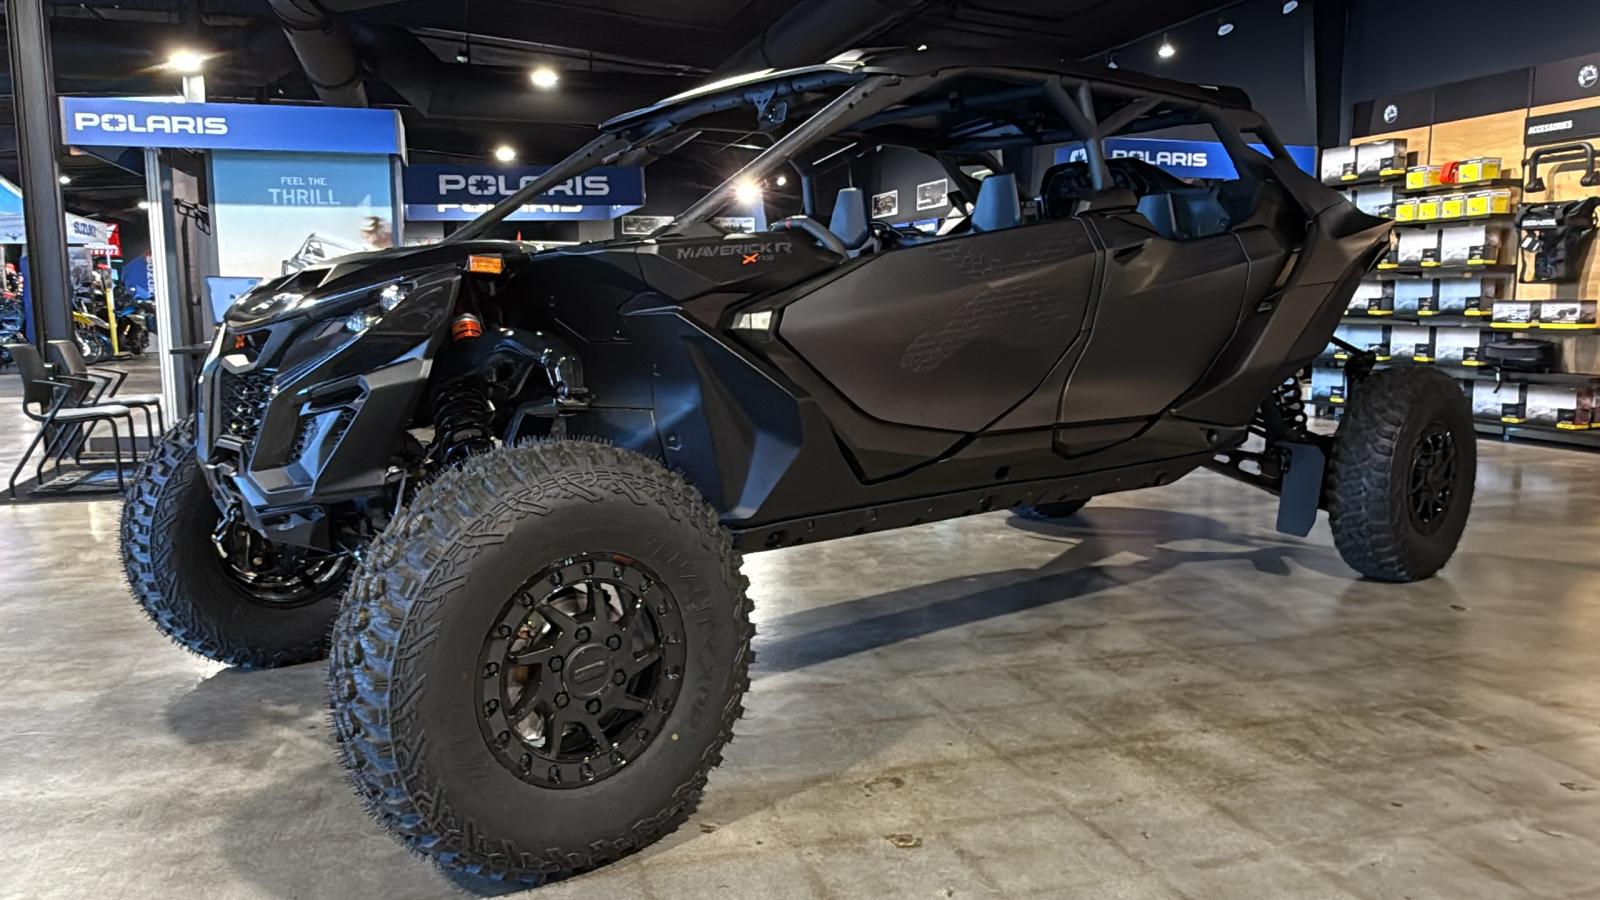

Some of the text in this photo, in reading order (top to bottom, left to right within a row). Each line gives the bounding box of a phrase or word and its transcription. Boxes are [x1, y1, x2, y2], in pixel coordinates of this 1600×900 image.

[75, 112, 228, 135] POLARIS
[1527, 120, 1573, 135] ACCESSORIES
[1112, 150, 1208, 167] POLARIS
[280, 176, 327, 186] FEEL THE
[268, 188, 341, 205] THRILL
[676, 243, 772, 260] MAVERICK
